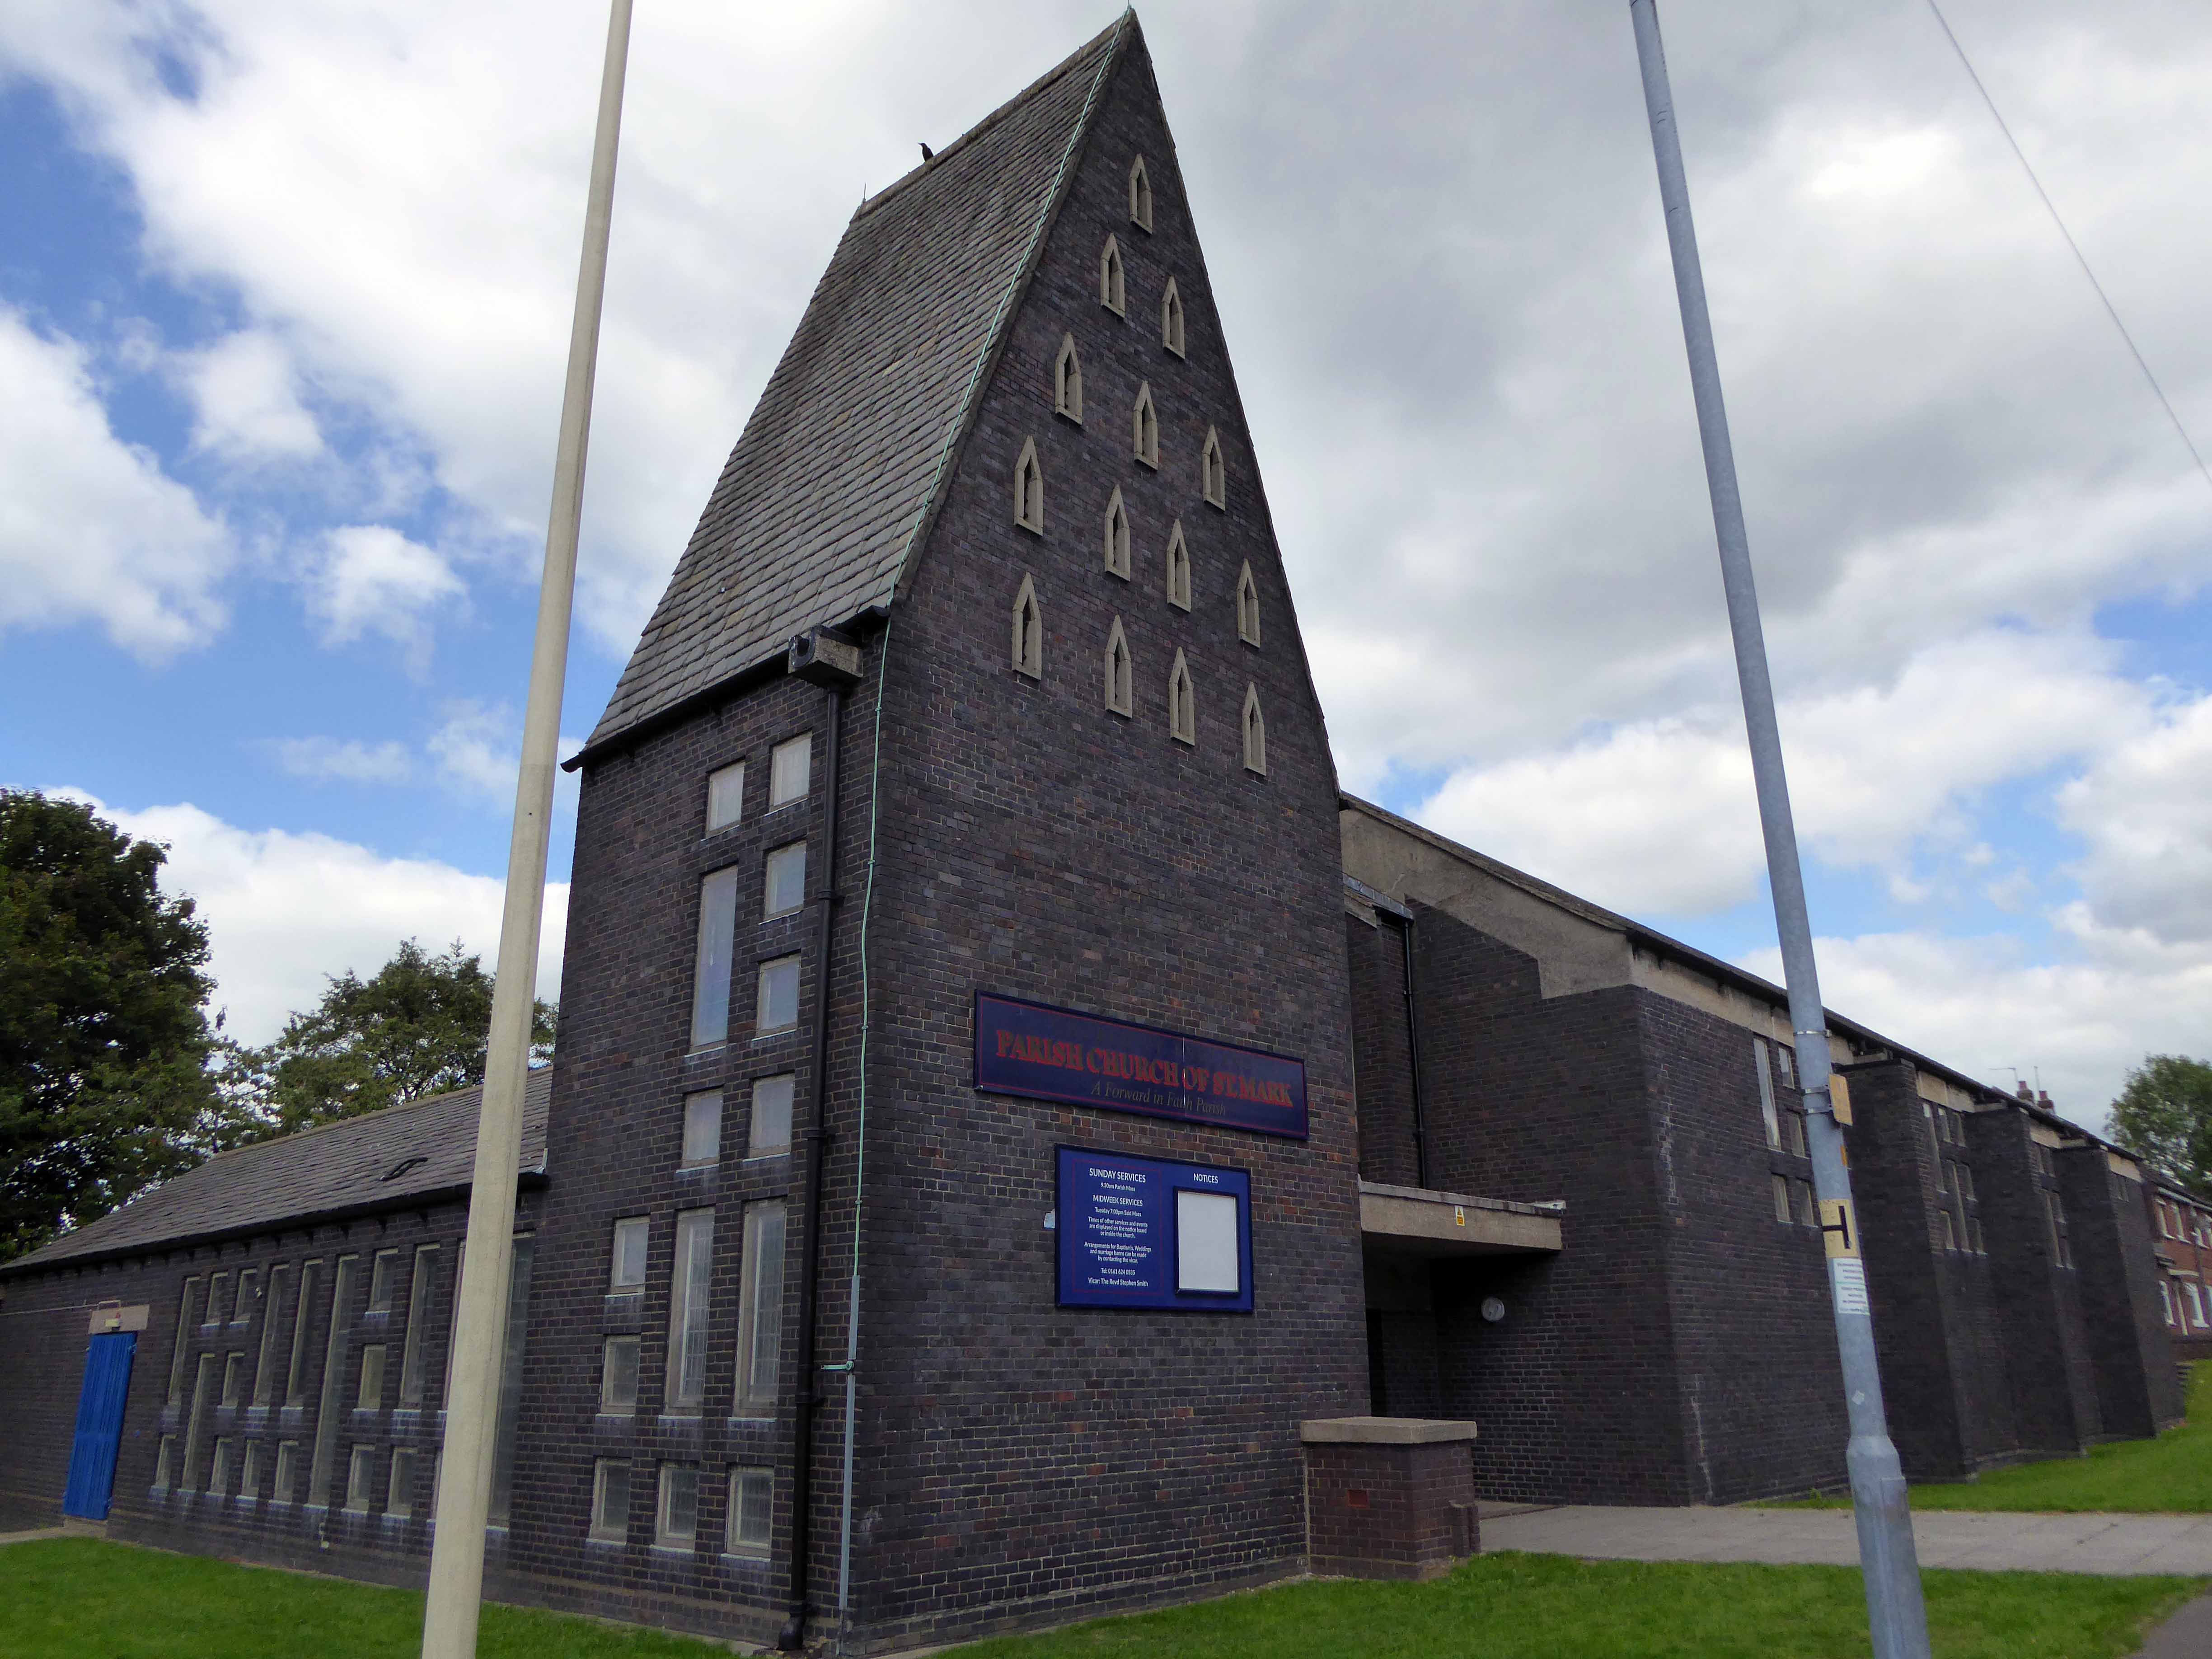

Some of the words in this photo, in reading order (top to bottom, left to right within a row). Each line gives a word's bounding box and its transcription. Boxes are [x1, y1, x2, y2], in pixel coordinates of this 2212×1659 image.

[996, 1030, 1083, 1071] PARISH
[1087, 1048, 1179, 1088] CHURCH
[1182, 1065, 1209, 1092] OF
[1091, 1080, 1101, 1096] A
[1105, 1081, 1150, 1103] Forward
[1153, 1093, 1163, 1106] in
[1197, 1097, 1226, 1116] Parish
[1089, 1168, 1116, 1179] SUNDAY
[1117, 1171, 1146, 1183] SERVICES
[1194, 1173, 1218, 1183] NOTICES
[1093, 1195, 1119, 1204] MIDWEEK
[1120, 1197, 1143, 1206] SERVICES
